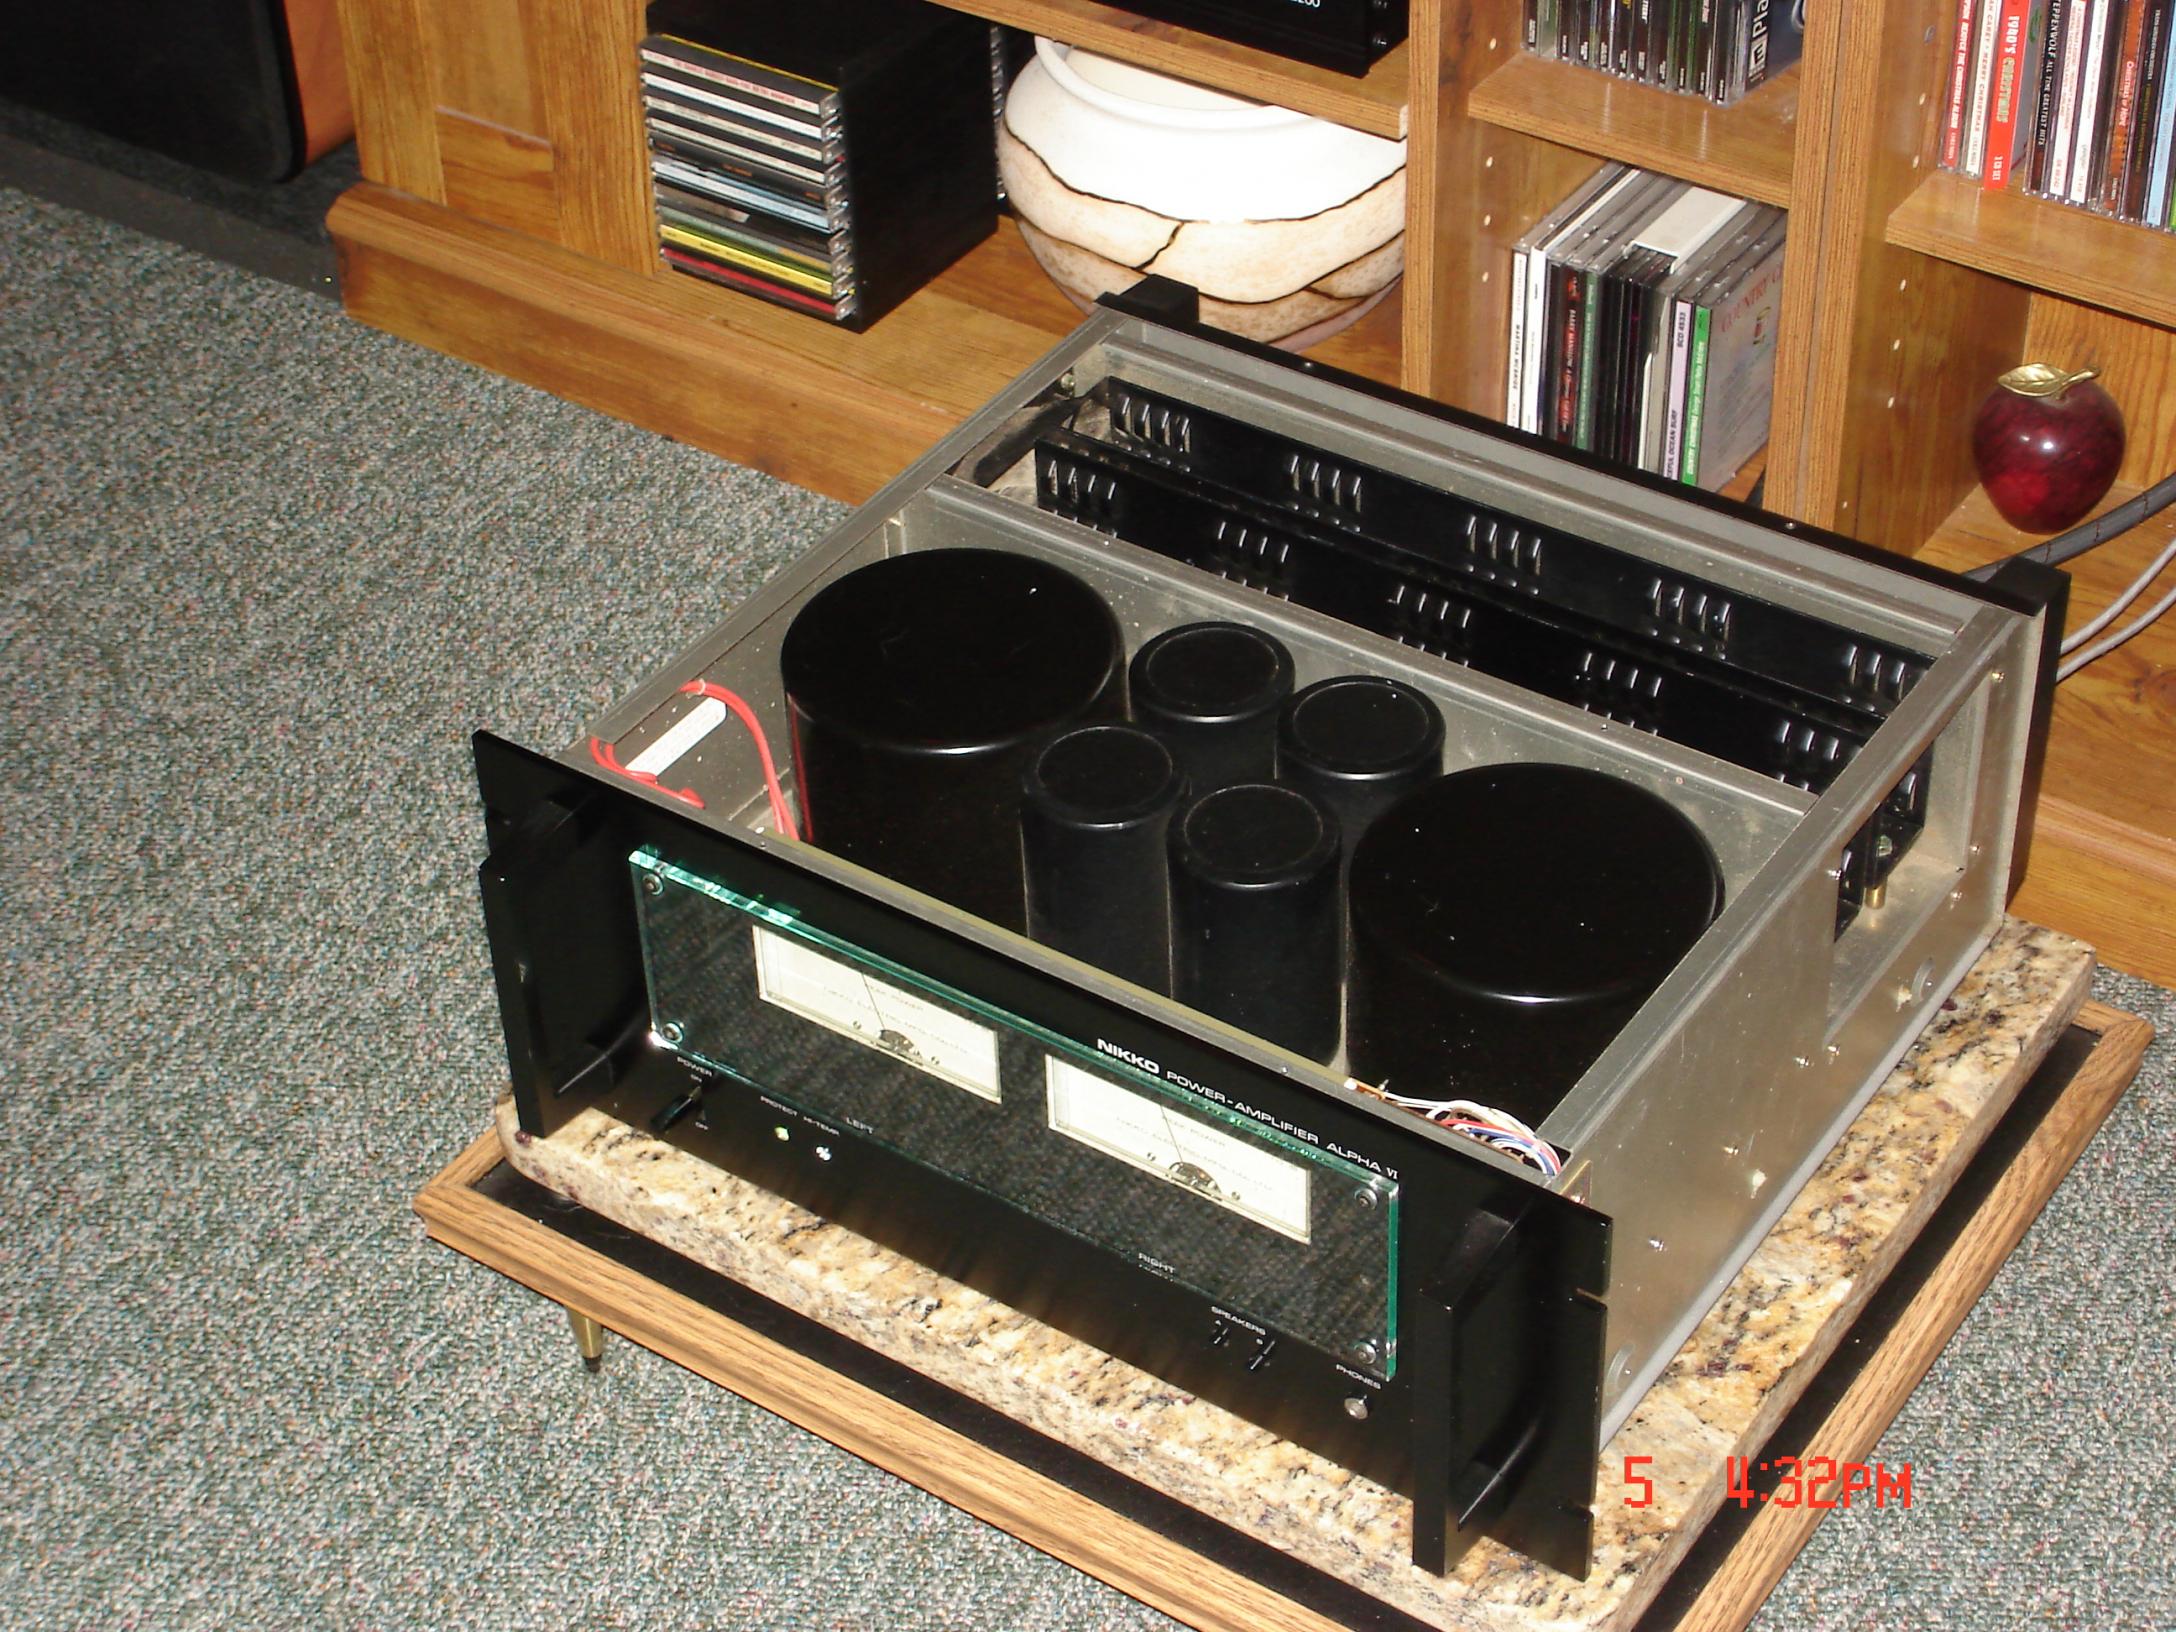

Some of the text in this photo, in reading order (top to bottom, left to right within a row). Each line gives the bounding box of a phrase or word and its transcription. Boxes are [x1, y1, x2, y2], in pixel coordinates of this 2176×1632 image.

[2005, 15, 2020, 54] 1940'S
[1980, 51, 1988, 80] MERRY
[1952, 66, 1964, 104] CHRISTMAS
[1996, 57, 2016, 123] CHRISTMAS
[1974, 83, 1984, 132] CHRISTMAS
[2040, 93, 2049, 127] GREATEST
[1669, 409, 1677, 428] SURF
[1667, 429, 1676, 455] OCEAN
[1096, 1038, 1160, 1075] NIKKO
[1326, 1141, 1382, 1173] ALPHA
[1386, 1167, 1399, 1180] VI
[845, 1116, 875, 1136] LEFT
[1137, 1252, 1176, 1275] RIGHT
[1210, 1305, 1267, 1336] SPEAKERS
[1335, 1363, 1382, 1390] PHONES
